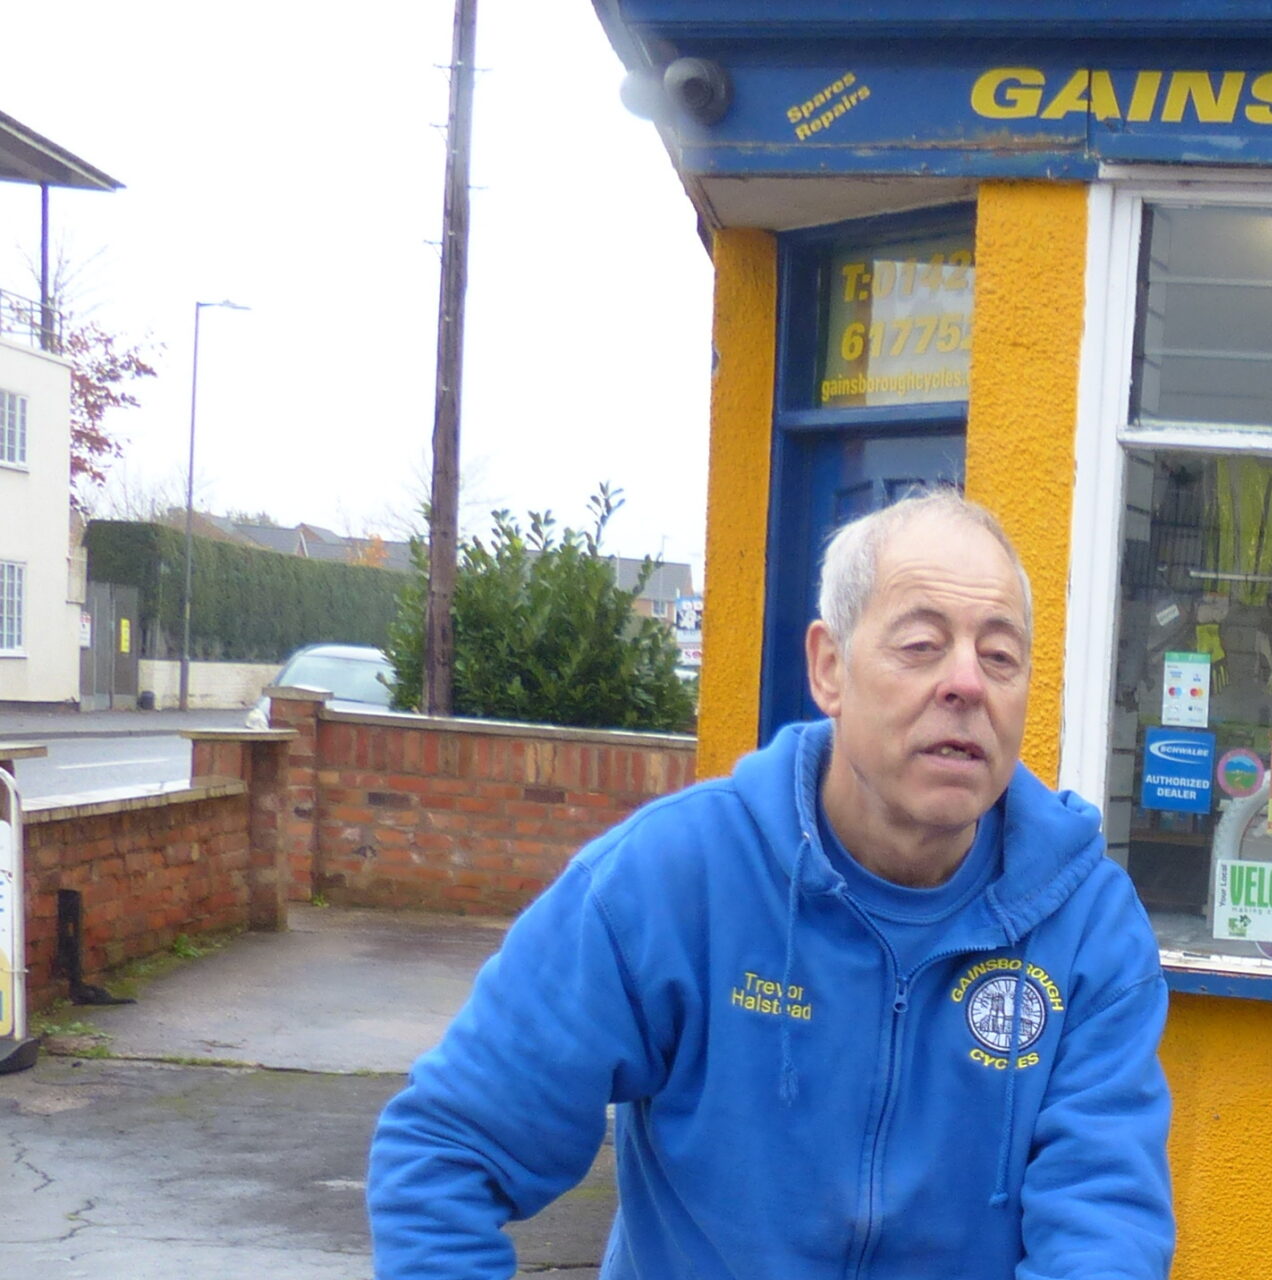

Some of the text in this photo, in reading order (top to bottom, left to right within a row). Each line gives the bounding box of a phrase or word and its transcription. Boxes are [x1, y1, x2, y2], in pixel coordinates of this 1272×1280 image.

[787, 73, 856, 123] Spares
[795, 86, 870, 140] Repairs
[1145, 774, 1210, 789] AUTHORIZED
[1157, 787, 1197, 800] DEALER
[1219, 864, 1228, 907] Your Local
[970, 1048, 1040, 1070] CYCES
